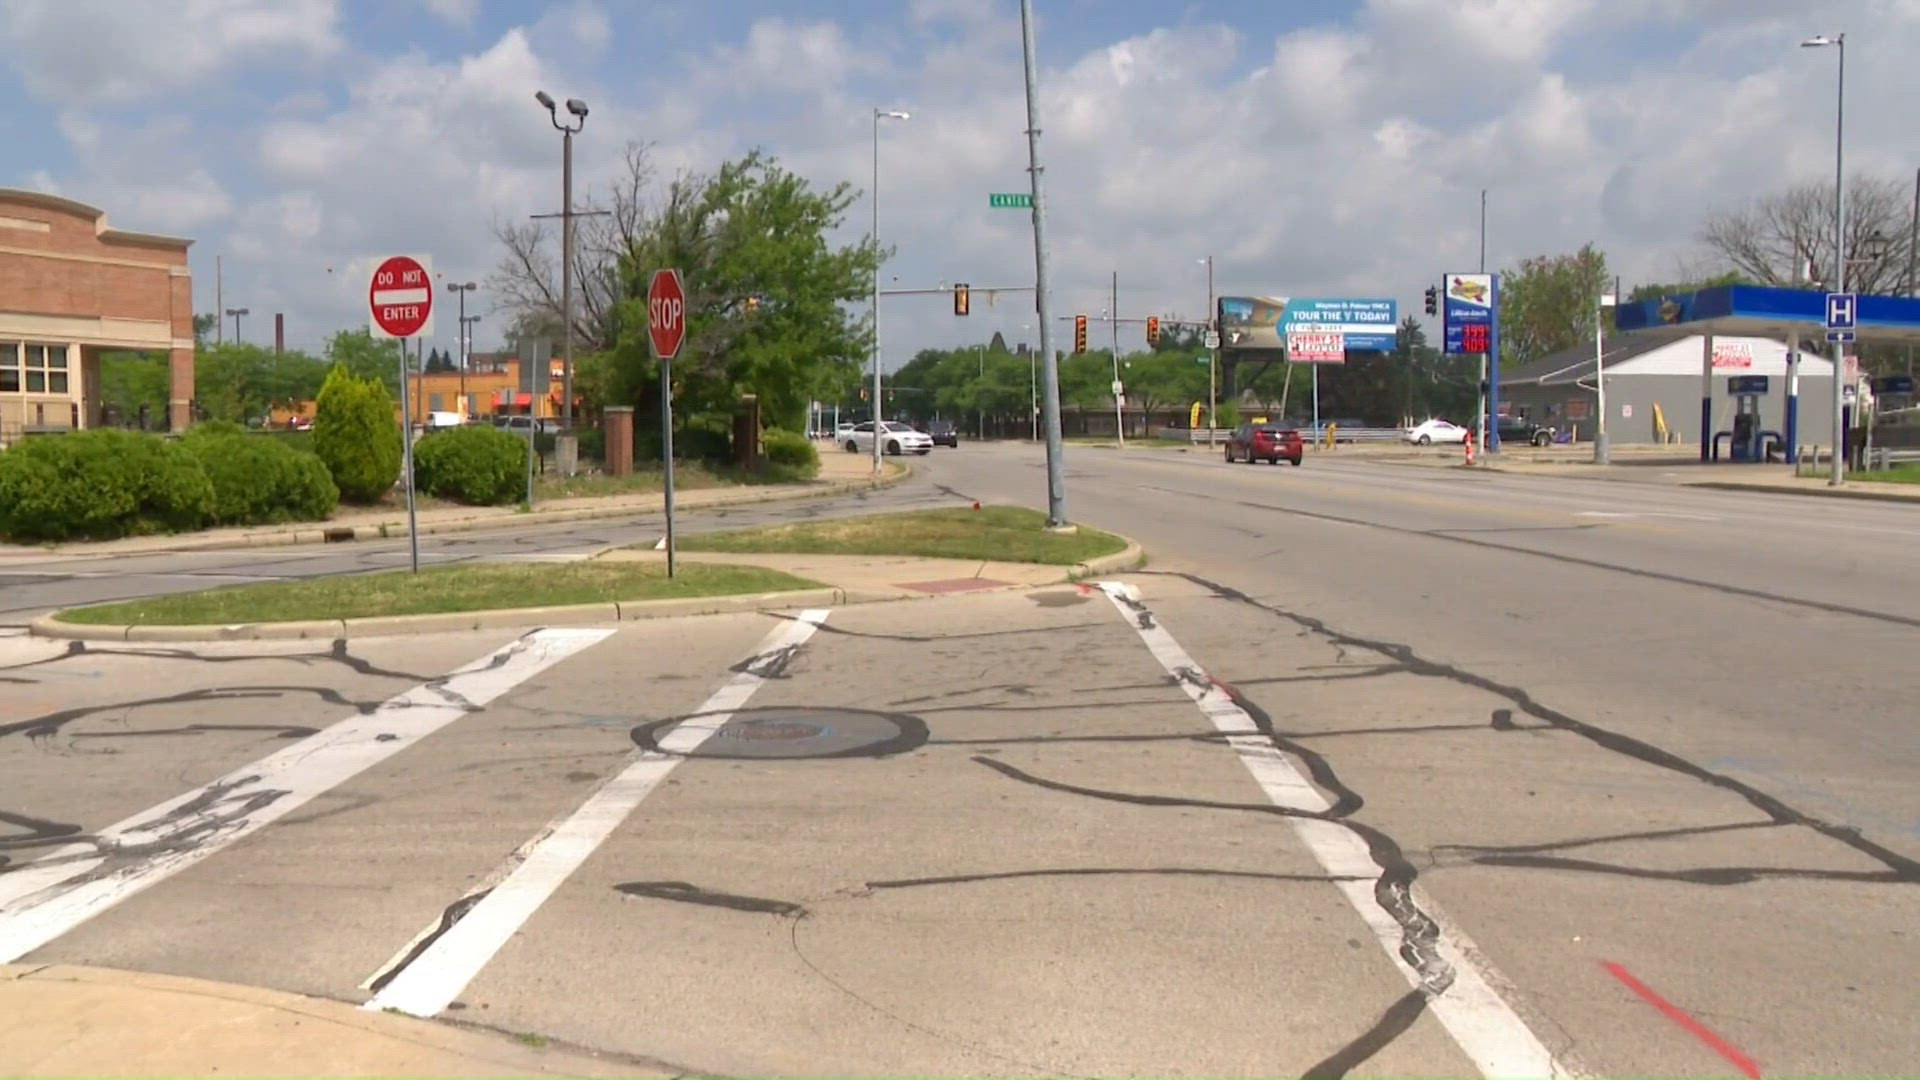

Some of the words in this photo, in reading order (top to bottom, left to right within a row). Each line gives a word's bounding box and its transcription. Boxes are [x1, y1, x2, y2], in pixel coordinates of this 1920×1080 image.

[993, 194, 1030, 206] CANTON
[378, 271, 394, 285] DO
[402, 269, 421, 284] NOT
[383, 306, 419, 320] ENTER
[651, 297, 681, 330] STOP
[1292, 311, 1320, 321] TOUR
[1322, 311, 1342, 321] THE
[1354, 311, 1390, 321] TODAY!
[1830, 299, 1851, 325] H
[1289, 335, 1326, 345] CHERRY
